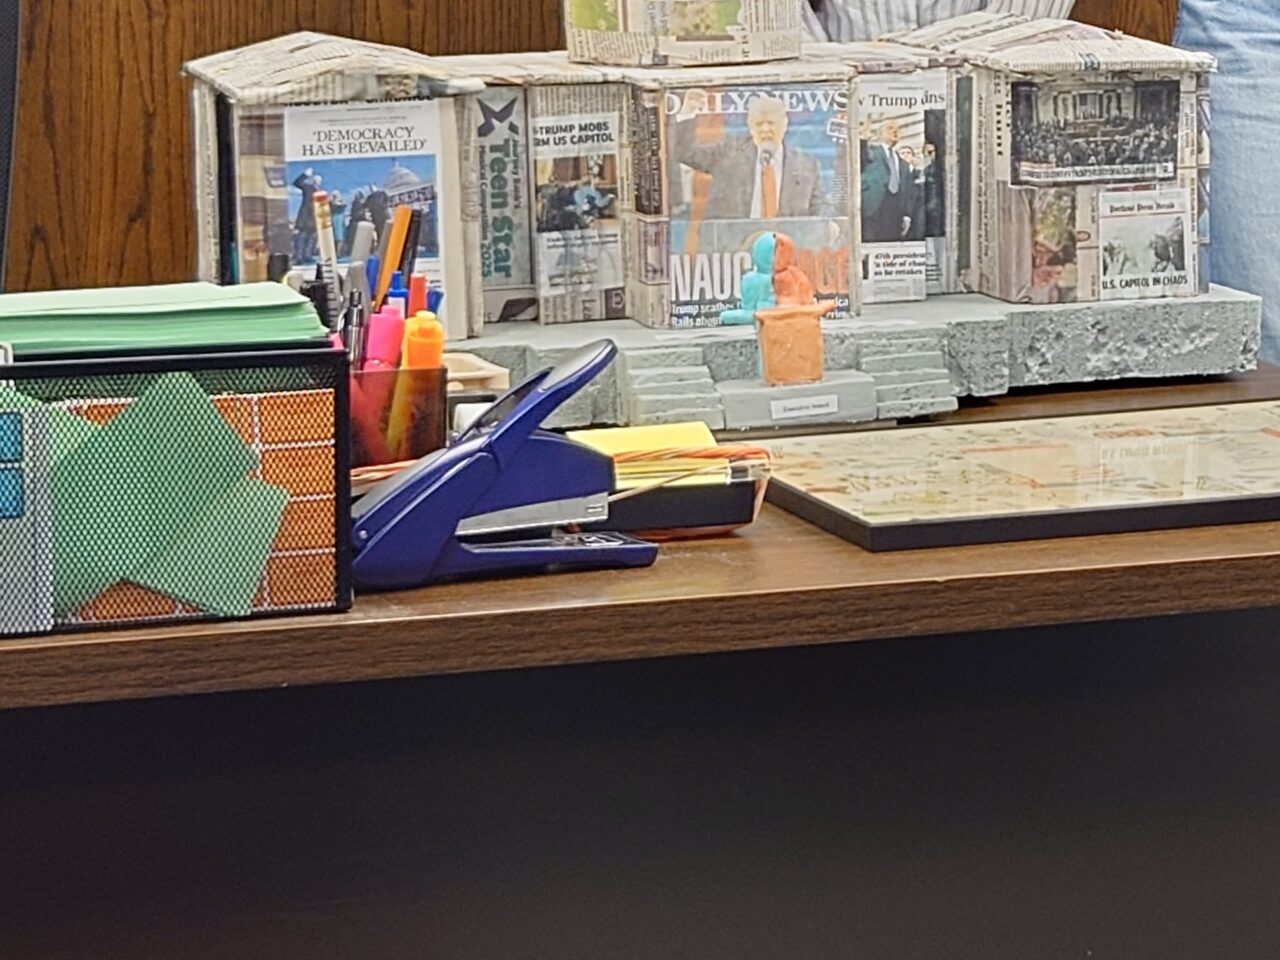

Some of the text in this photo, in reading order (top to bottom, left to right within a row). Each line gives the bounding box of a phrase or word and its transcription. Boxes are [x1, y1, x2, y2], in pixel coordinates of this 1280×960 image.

[868, 93, 918, 110] Trump
[579, 121, 609, 133] MOBS
[553, 136, 567, 146] US
[570, 133, 615, 145] CAPITOL
[302, 143, 335, 157] HAS
[489, 138, 514, 278] Teen Star
[481, 242, 492, 278] 2025
[1119, 277, 1150, 288] CAPITOL
[1163, 275, 1188, 286] CHAOS
